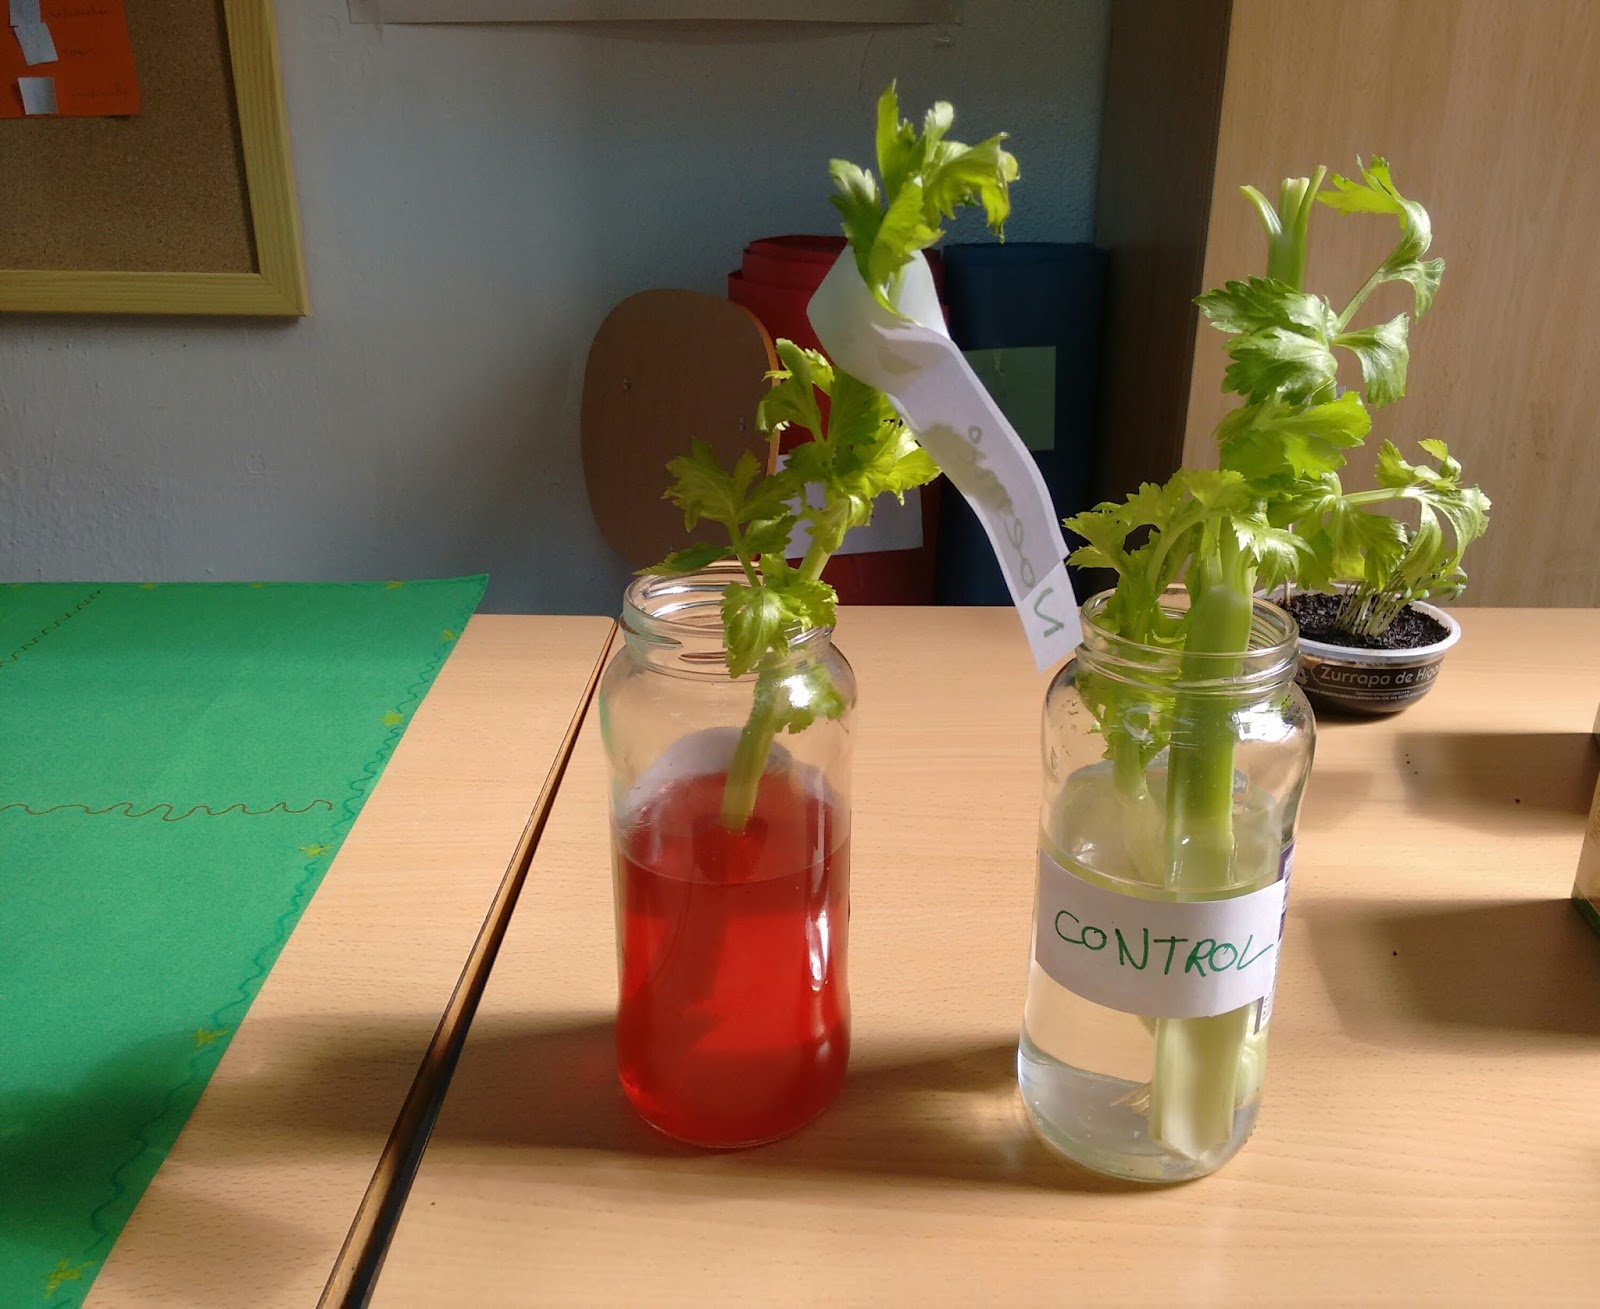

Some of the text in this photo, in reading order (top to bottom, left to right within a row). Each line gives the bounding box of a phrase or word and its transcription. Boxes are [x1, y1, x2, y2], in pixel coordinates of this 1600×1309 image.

[1320, 666, 1390, 688] Zurrapa
[1395, 671, 1413, 685] de
[1054, 909, 1275, 978] CONTROL
